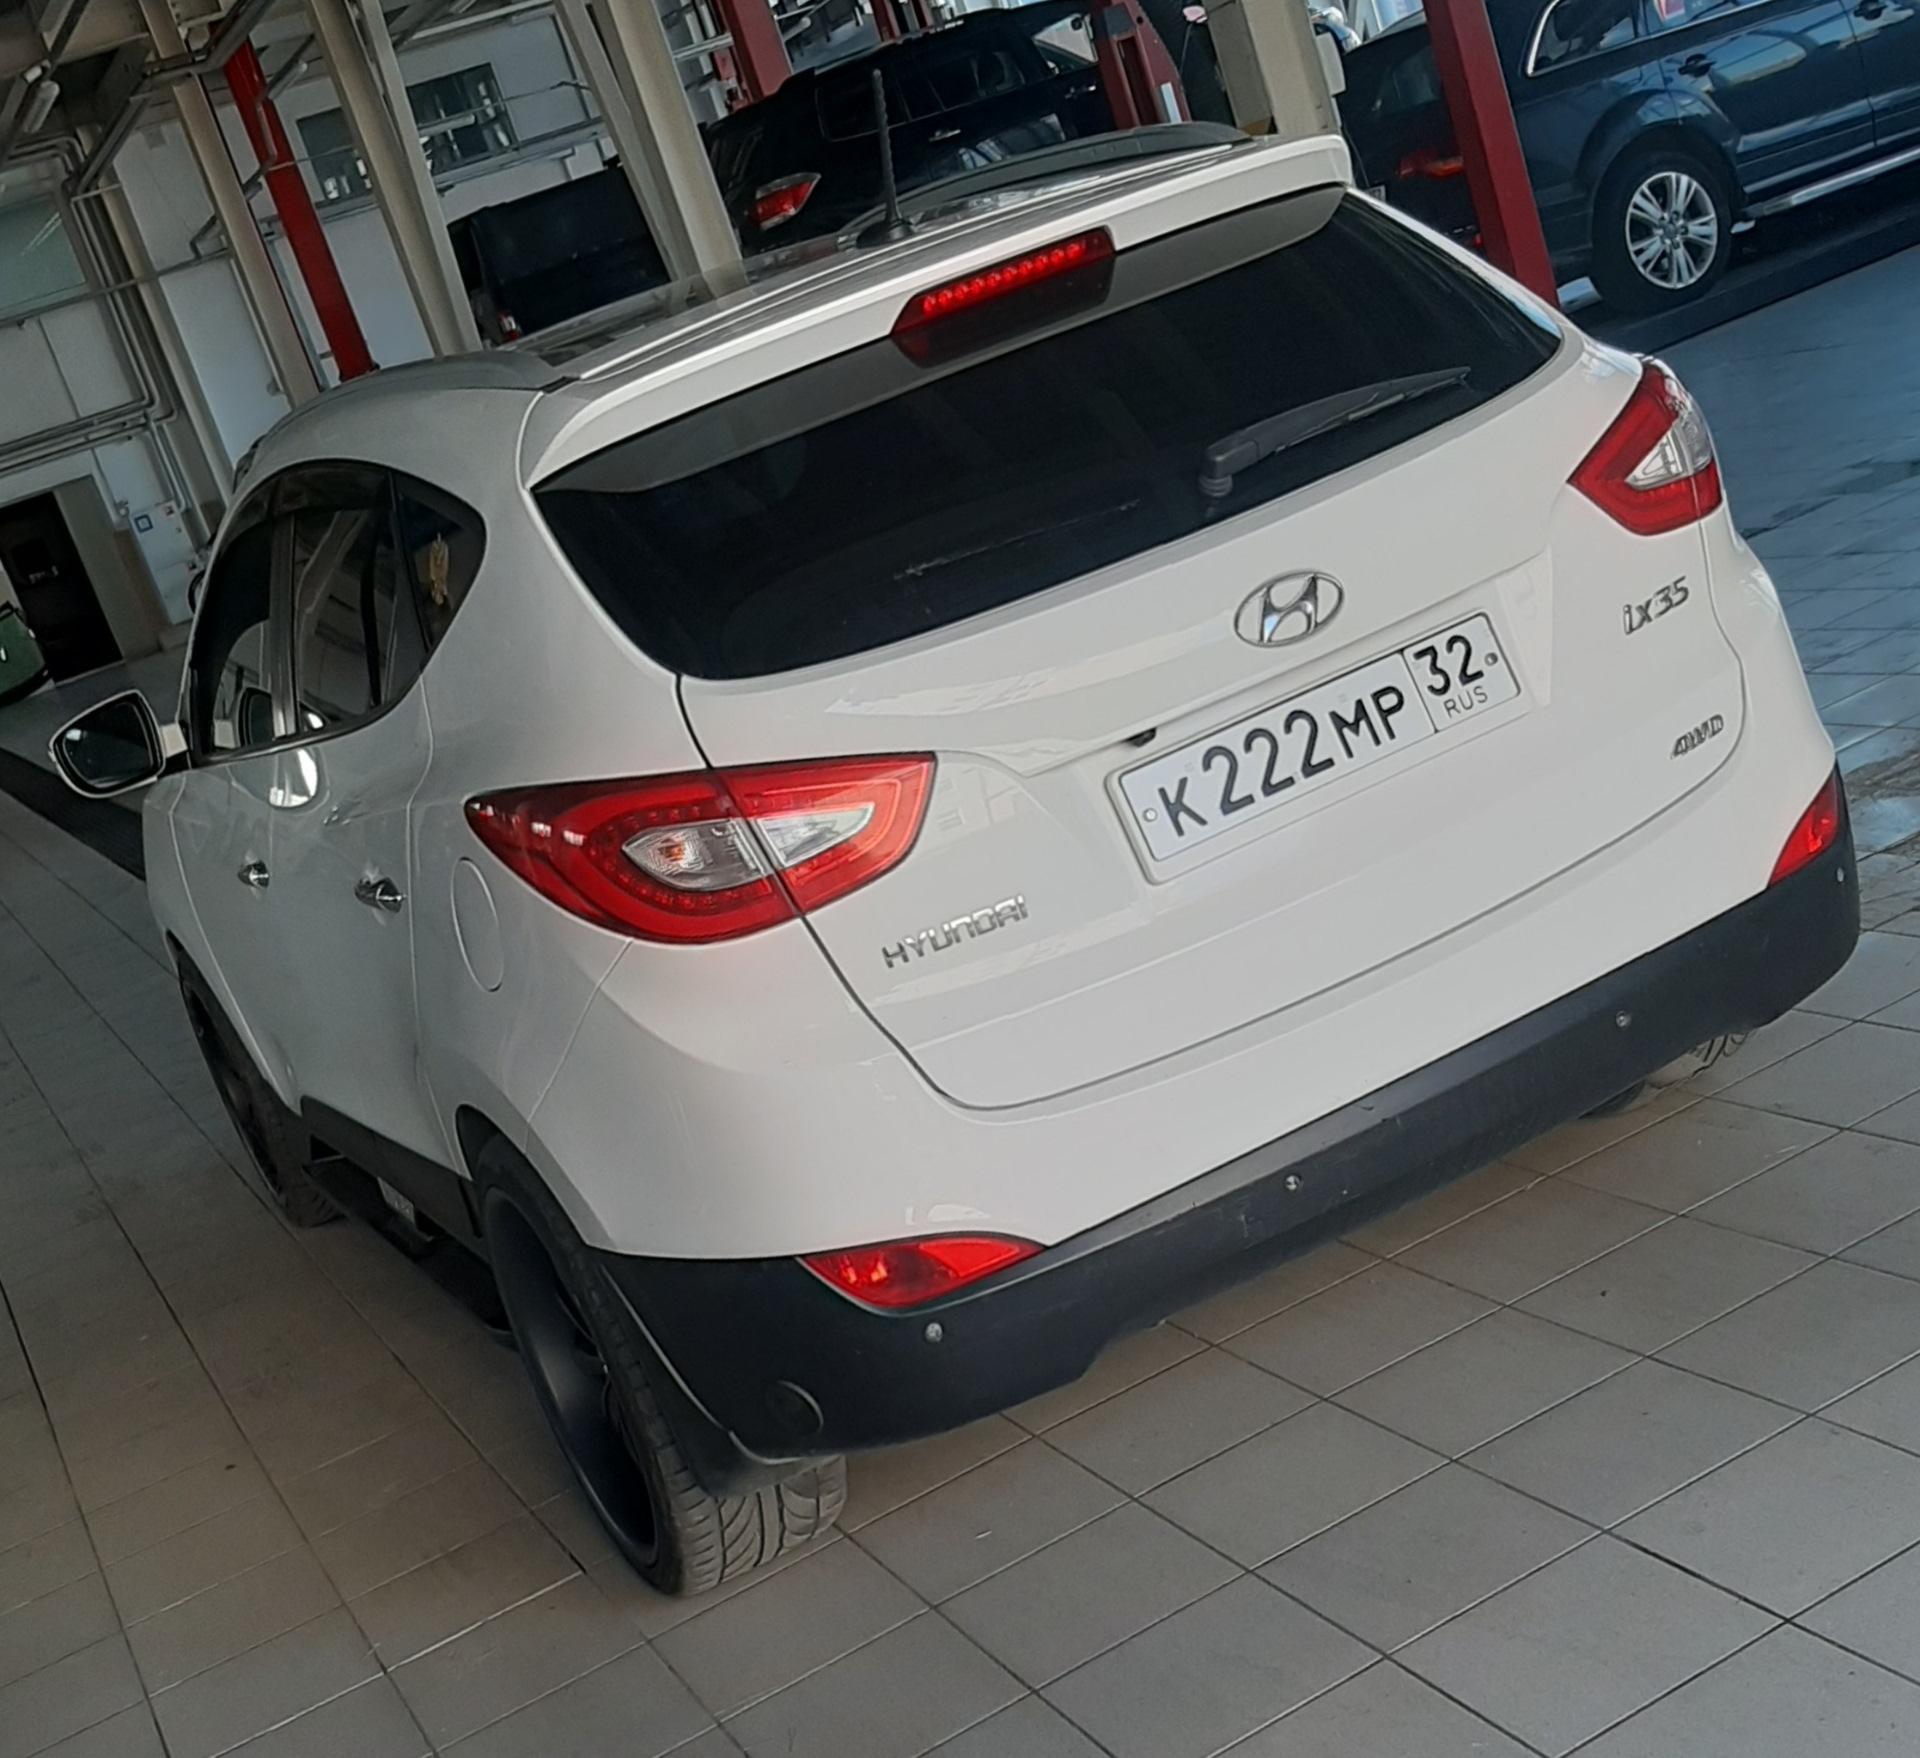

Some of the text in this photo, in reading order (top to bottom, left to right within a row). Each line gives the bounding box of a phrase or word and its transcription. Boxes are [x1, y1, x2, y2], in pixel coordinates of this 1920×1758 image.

[1413, 634, 1485, 697] 32
[1443, 685, 1489, 718] RUS
[1669, 713, 1725, 760] 4WD
[881, 894, 1029, 969] HYUNDAI
